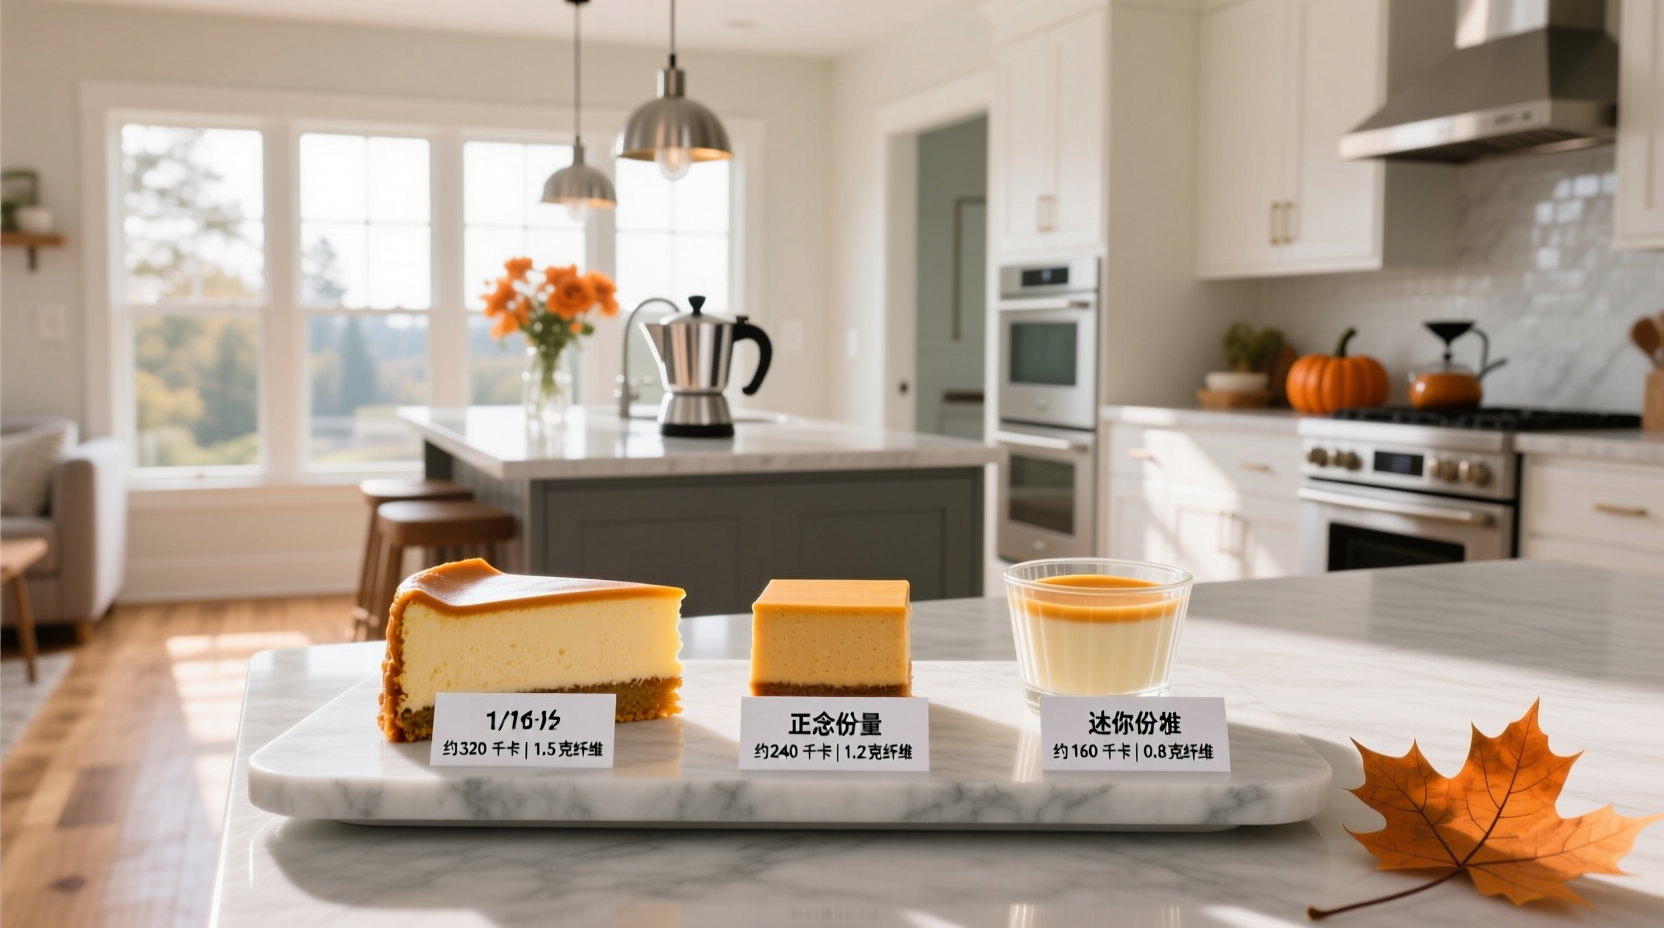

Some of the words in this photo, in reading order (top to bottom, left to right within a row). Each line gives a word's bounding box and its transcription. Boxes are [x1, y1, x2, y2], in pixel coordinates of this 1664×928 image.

[788, 710, 882, 737] 正念份量
[491, 740, 521, 758] 千卡
[802, 742, 833, 761] 千卡
[1102, 742, 1131, 761] 千卡
